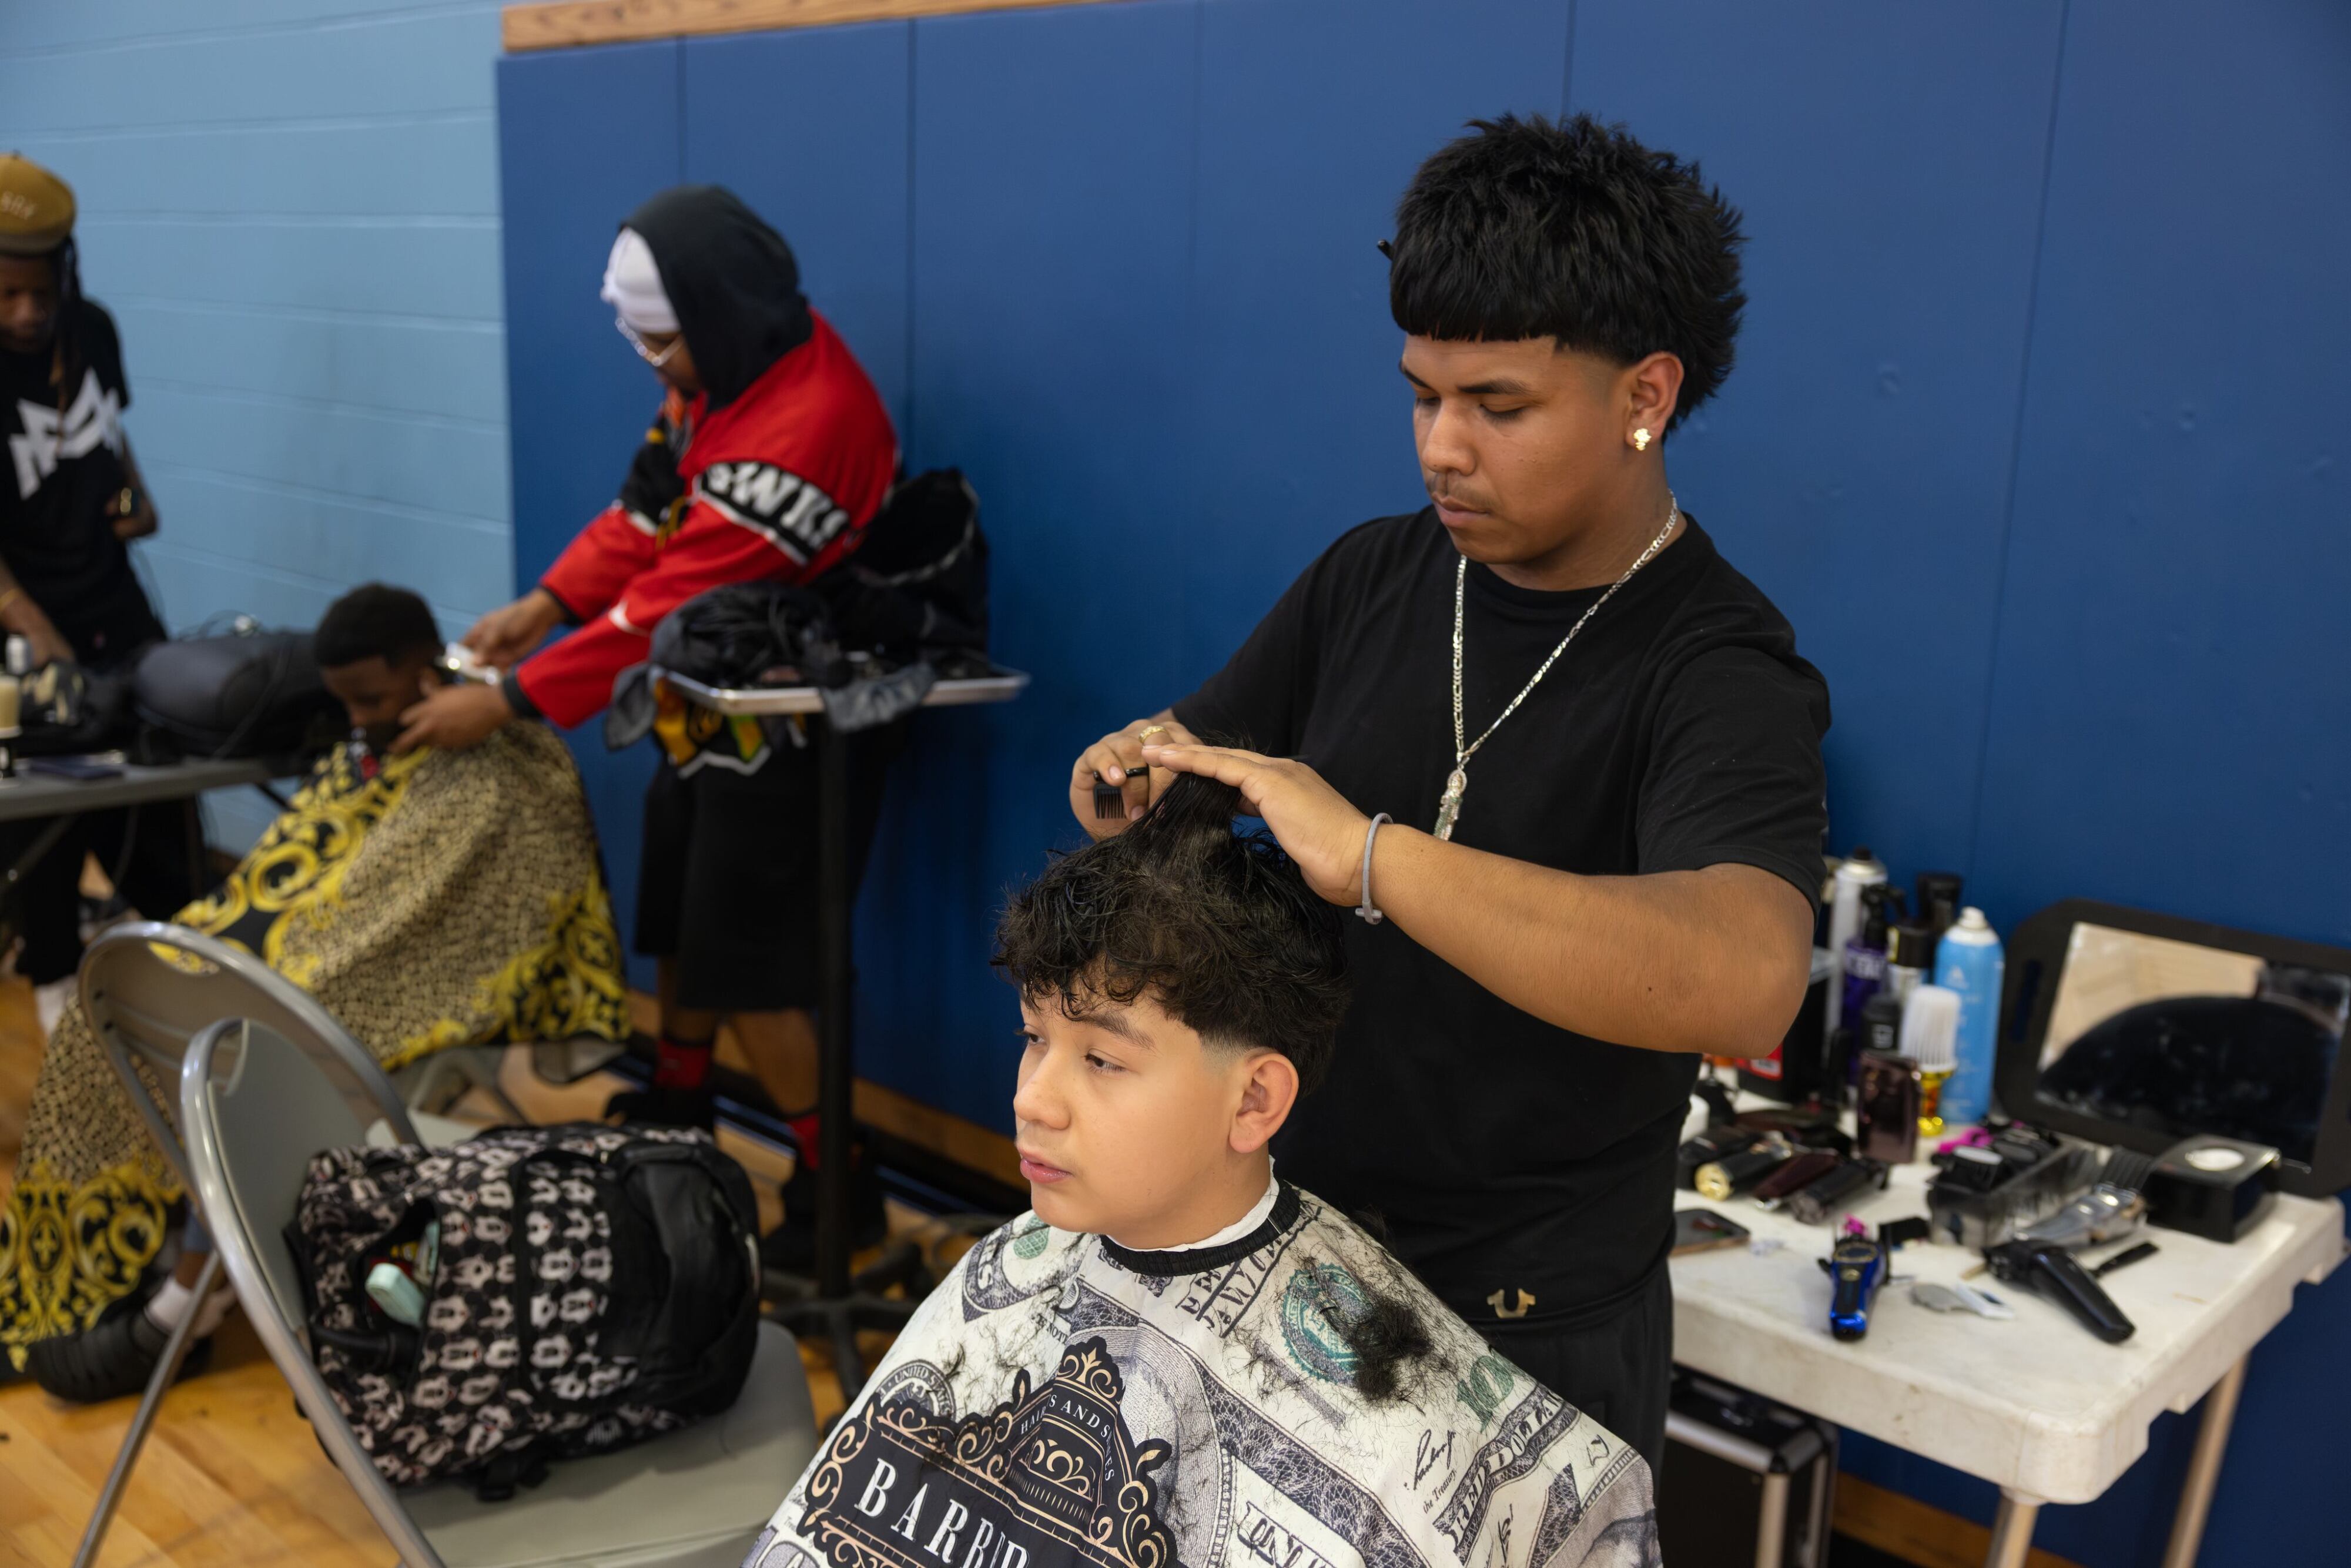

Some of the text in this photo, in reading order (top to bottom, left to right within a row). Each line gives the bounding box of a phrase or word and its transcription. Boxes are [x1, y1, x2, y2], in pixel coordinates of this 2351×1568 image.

[894, 1365, 929, 1383] UNITED
[1060, 1399, 1101, 1428] AND
[1100, 1424, 1115, 1482] SHVES
[1423, 1497, 1434, 1515] the
